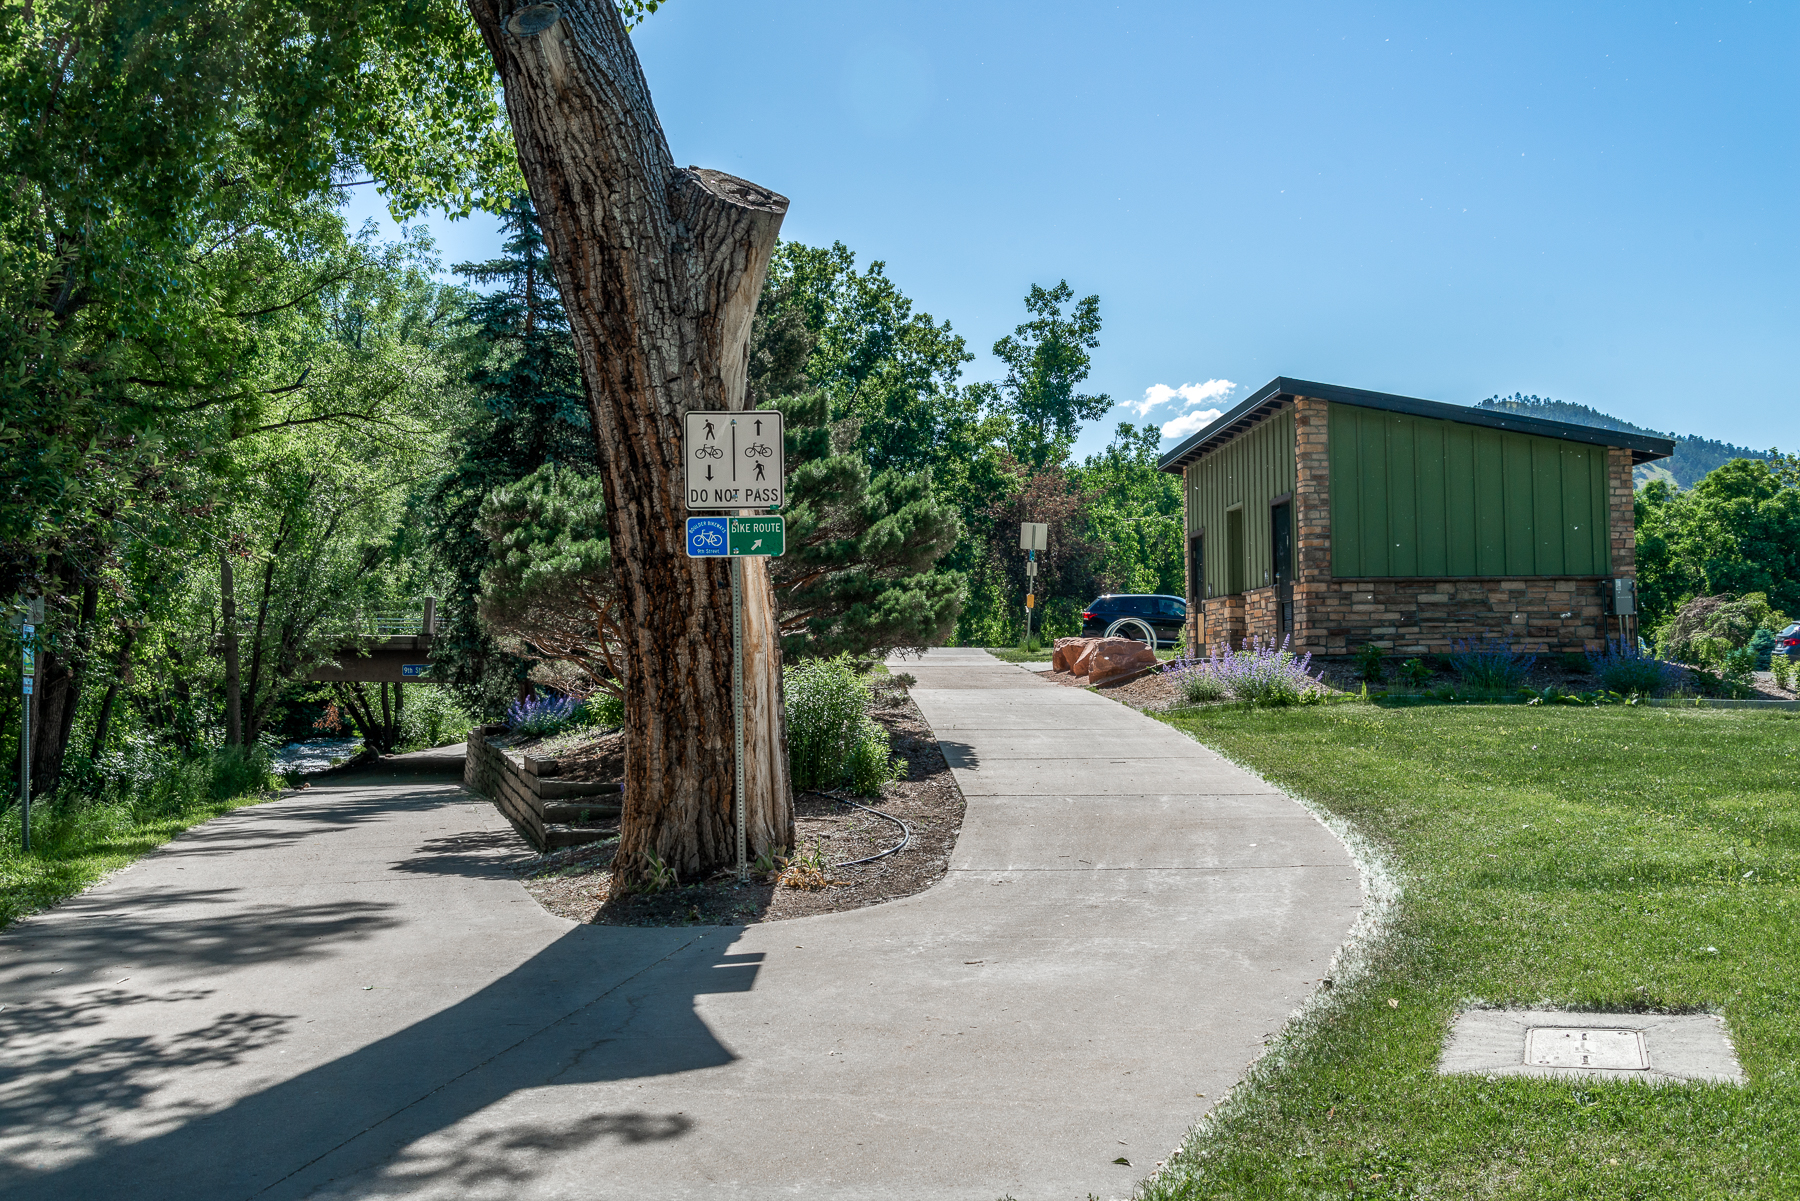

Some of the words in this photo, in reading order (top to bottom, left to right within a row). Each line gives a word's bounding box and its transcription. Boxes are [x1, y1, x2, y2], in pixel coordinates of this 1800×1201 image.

[690, 489, 708, 502] DO
[714, 488, 740, 503] NOT
[745, 488, 779, 502] PASS
[689, 520, 707, 534] BOULDER
[731, 523, 751, 533] BIKE
[753, 522, 781, 533] ROUTE
